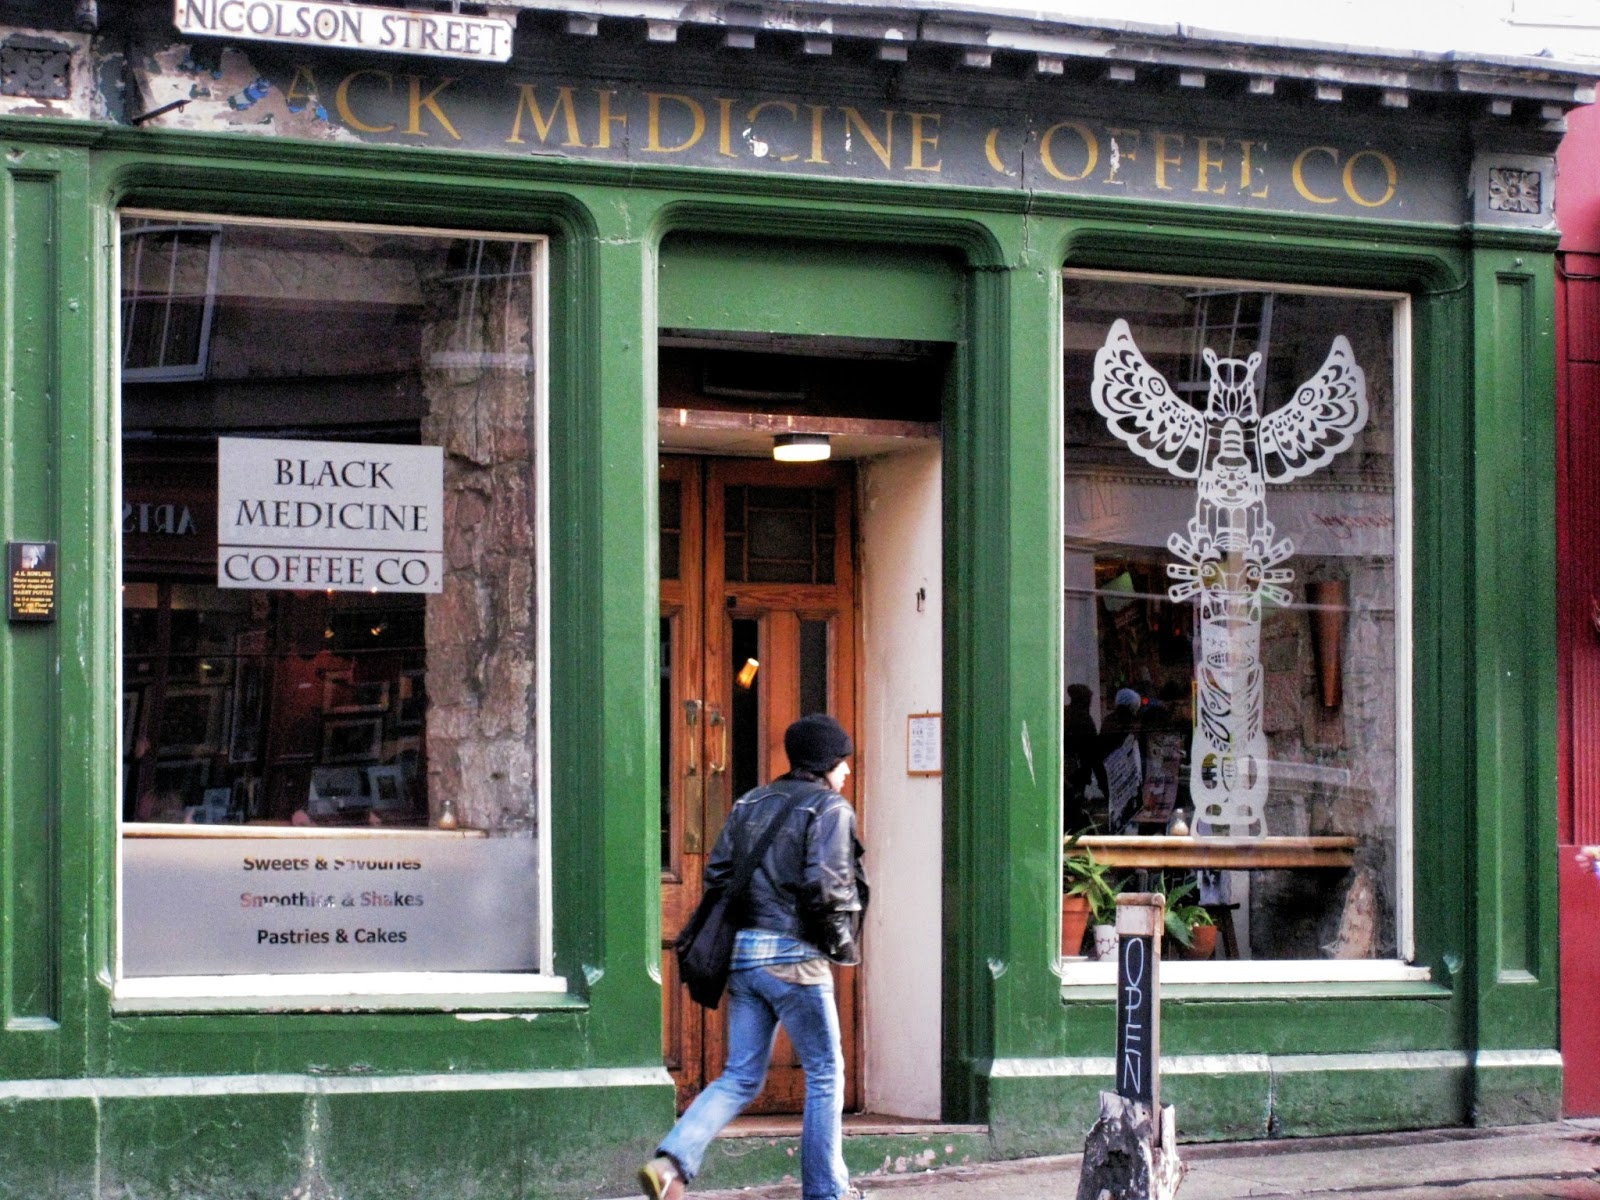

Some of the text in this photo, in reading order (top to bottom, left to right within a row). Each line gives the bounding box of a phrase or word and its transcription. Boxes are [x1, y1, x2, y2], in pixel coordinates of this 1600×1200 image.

[184, 0, 505, 56] NICOLSON STREET
[505, 83, 943, 173] MEDICINE
[985, 122, 1269, 198] COFFEE
[1292, 145, 1397, 208] CO
[274, 458, 394, 490] BLACK
[235, 499, 429, 532] MEDICINE
[224, 553, 439, 586] COFFEE CO.
[243, 857, 310, 872] Sweets
[315, 856, 328, 871] &
[341, 894, 356, 908] &
[360, 891, 424, 908] Shakes
[257, 928, 408, 944] Pastries & Cakes
[1123, 937, 1145, 1095] OPEN
